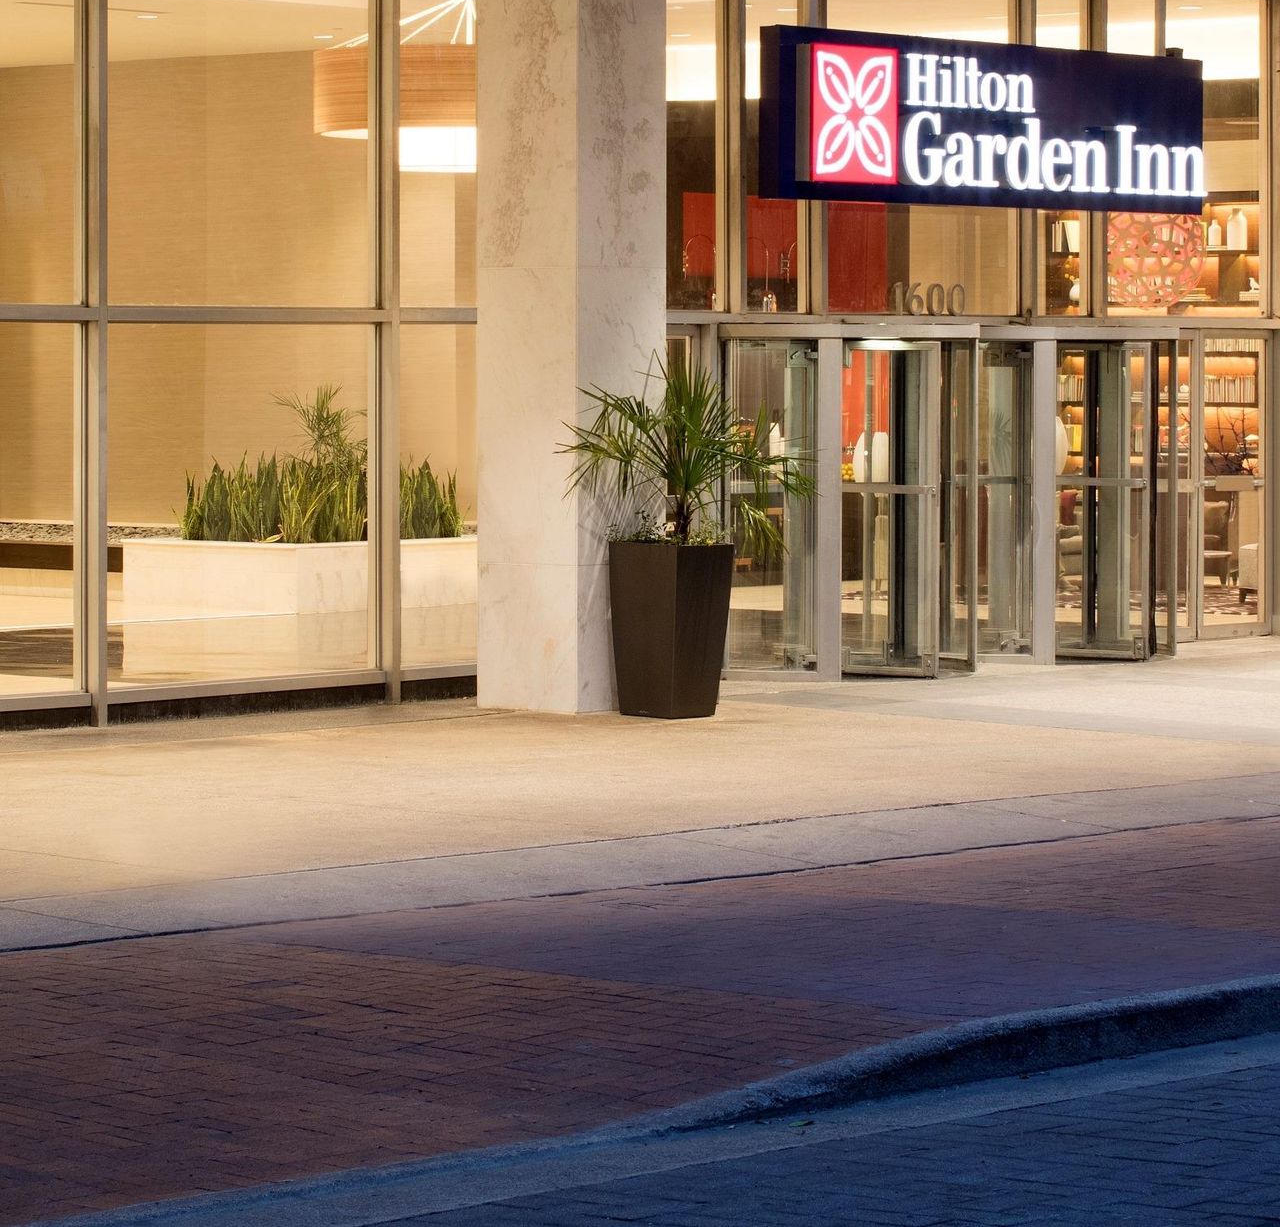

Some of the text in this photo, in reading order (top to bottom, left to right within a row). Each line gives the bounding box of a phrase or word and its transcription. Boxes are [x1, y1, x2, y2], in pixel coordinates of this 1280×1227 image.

[905, 54, 1036, 113] Hilton
[903, 111, 1208, 197] Garden Inn
[894, 281, 965, 316] 1600
